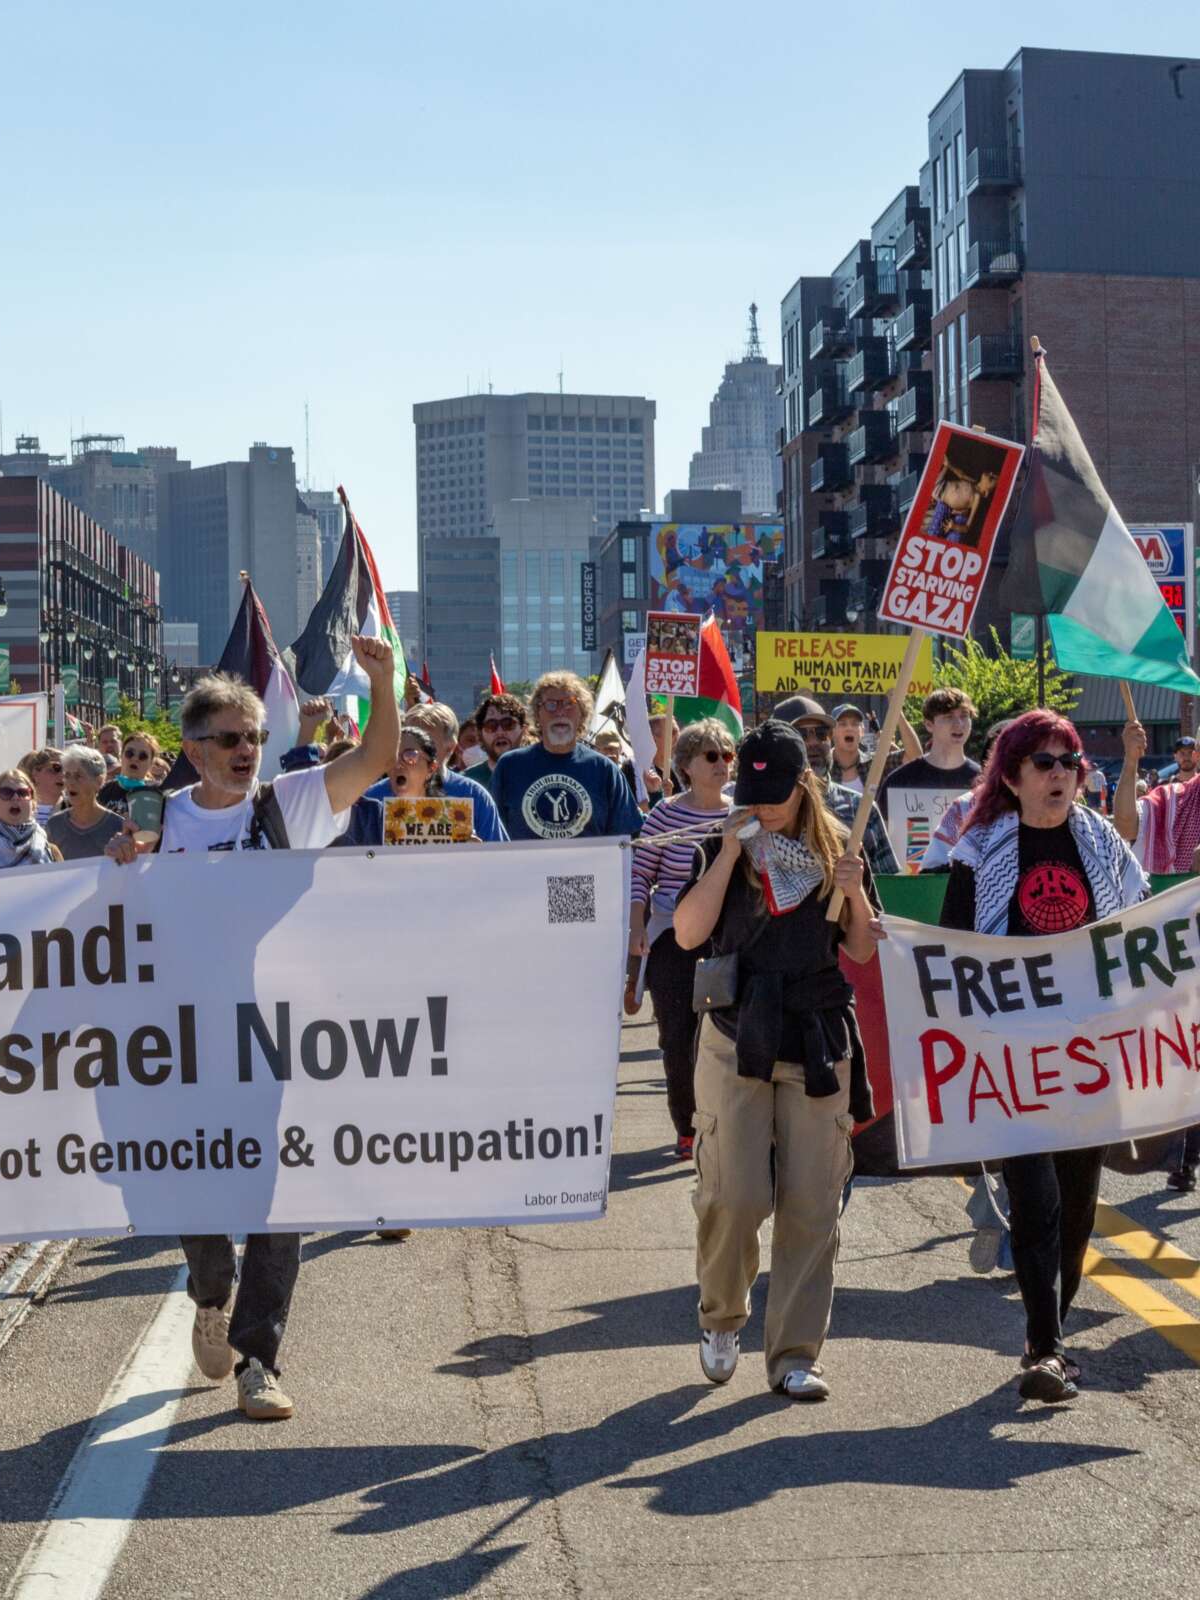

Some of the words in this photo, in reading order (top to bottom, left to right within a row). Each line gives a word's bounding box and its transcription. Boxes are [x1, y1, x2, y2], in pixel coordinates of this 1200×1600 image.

[901, 535, 982, 582] STOP
[583, 564, 594, 623] GODFREY
[895, 566, 975, 602] STARVING
[888, 585, 965, 632] GAZA
[584, 625, 595, 648] THE
[774, 638, 858, 660] RELEASE
[647, 671, 695, 682] STARVING
[648, 658, 695, 673] STOP
[794, 660, 902, 679] HUMANITARIA
[646, 680, 695, 694] GAZA
[776, 677, 799, 692] AID
[809, 678, 831, 692] TO
[842, 679, 884, 694] GAZA
[907, 680, 933, 695] OW
[405, 823, 424, 836] WE
[428, 823, 453, 836] ARE
[542, 829, 573, 839] UNION
[912, 944, 1063, 1018] FREE
[1089, 911, 1200, 1000] FRE
[236, 995, 450, 1083] Now!
[56, 1127, 262, 1175] Genocide
[278, 1125, 315, 1167] &
[332, 1114, 605, 1172] Occupation!
[524, 1193, 557, 1206] Labor
[560, 1189, 603, 1205] Donated
